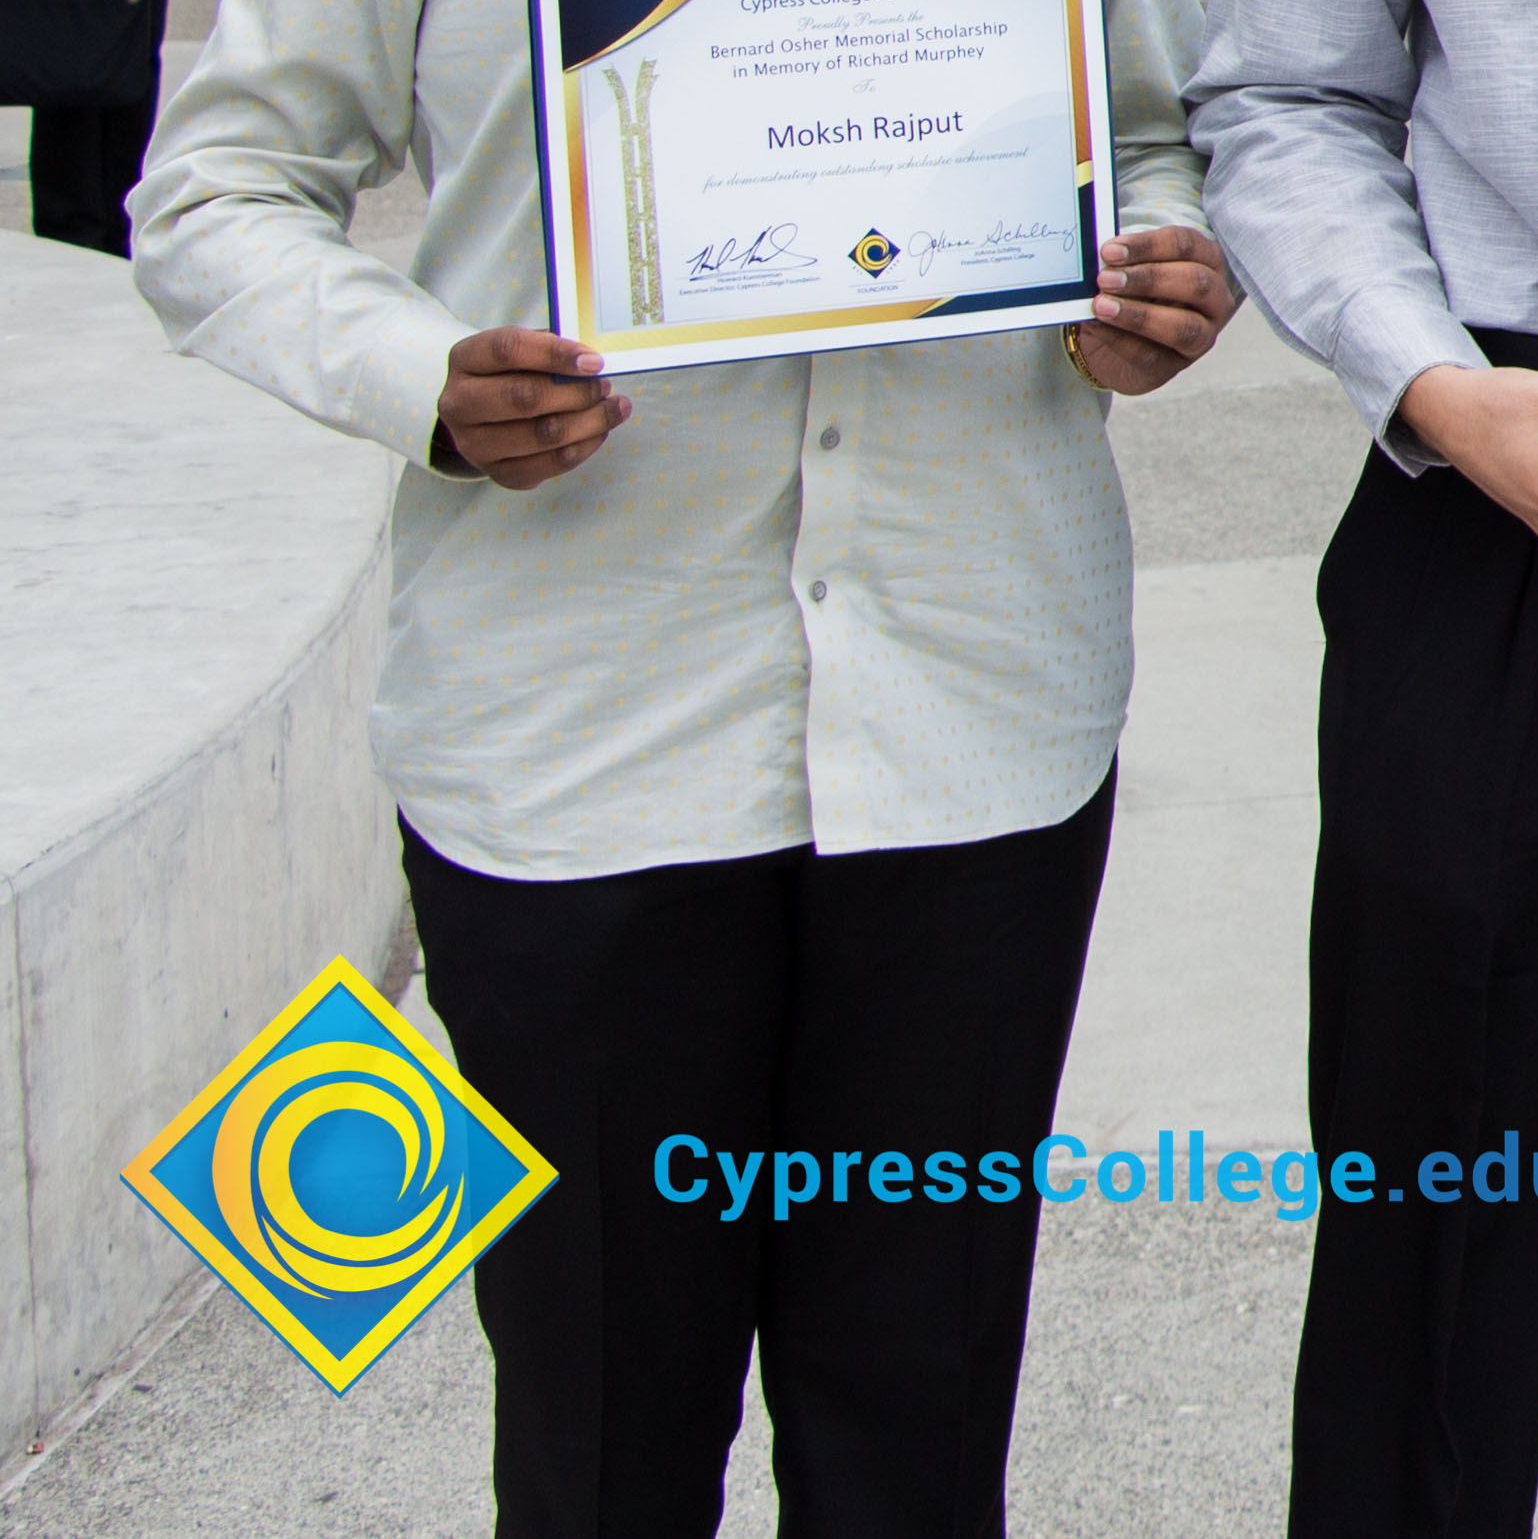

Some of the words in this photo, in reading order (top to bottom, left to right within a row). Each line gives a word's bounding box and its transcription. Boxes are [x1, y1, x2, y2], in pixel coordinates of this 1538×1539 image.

[710, 39, 774, 59] Bernard
[780, 37, 829, 53] Osher
[835, 28, 910, 48] Memorial
[915, 21, 1008, 42] Scholarship
[733, 67, 748, 78] in
[754, 61, 820, 76] Memory
[825, 54, 842, 70] of
[848, 49, 908, 68] Richard
[914, 45, 984, 62] Murphey
[768, 118, 862, 149] Moksh
[873, 111, 963, 142] Rajput
